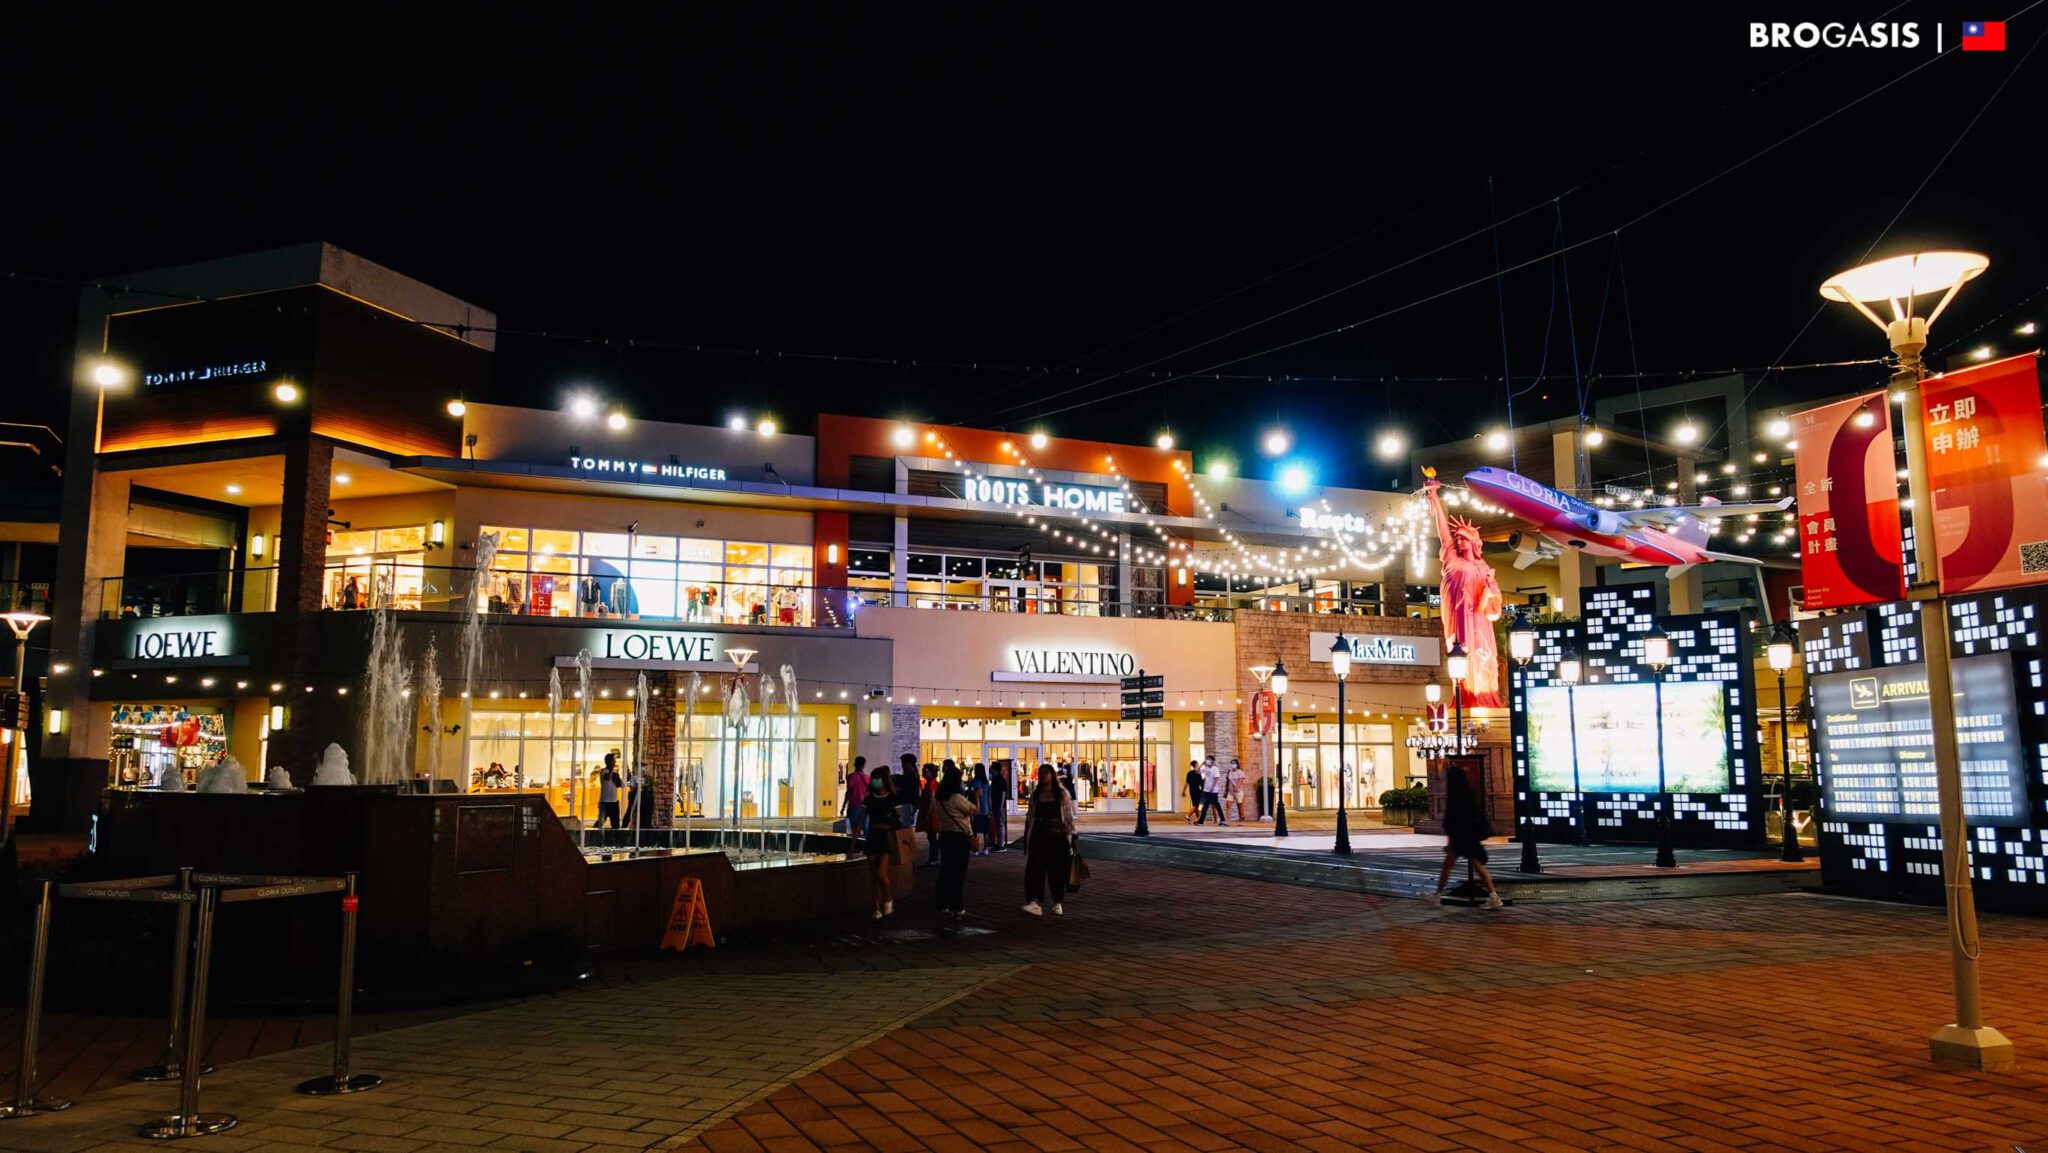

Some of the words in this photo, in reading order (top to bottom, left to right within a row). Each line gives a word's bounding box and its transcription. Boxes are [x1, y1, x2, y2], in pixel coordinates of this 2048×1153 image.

[1929, 396, 1976, 426] 立即
[1932, 425, 1980, 455] 申辦
[571, 457, 638, 473] TOMMY
[661, 465, 726, 481] HILFIGER
[965, 478, 1029, 505] ROOTS
[1043, 486, 1124, 513] HOME
[1506, 472, 1570, 511] GLORIA
[1804, 477, 1833, 496] 全新
[1806, 518, 1836, 535] 會員
[134, 631, 217, 659] LOEWE
[606, 633, 714, 661] LOEWE
[1013, 650, 1135, 676] VALENTINO
